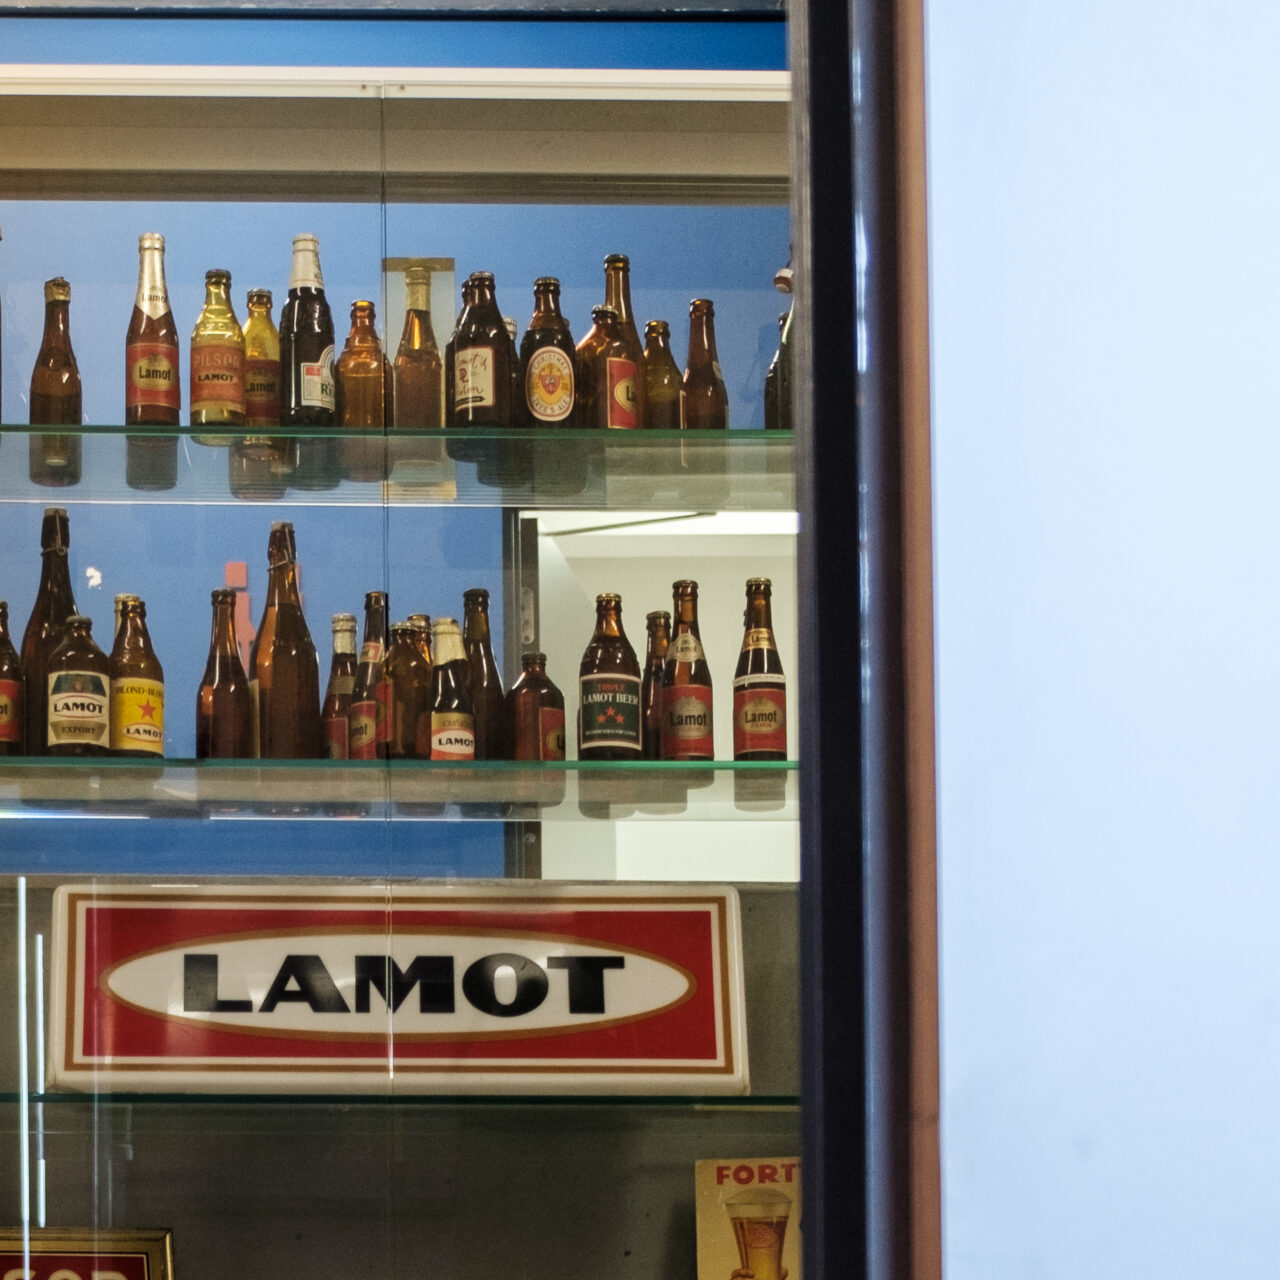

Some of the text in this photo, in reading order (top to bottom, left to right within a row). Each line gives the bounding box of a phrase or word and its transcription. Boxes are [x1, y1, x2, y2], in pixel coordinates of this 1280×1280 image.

[139, 365, 171, 380] Lamot
[198, 373, 234, 382] LAMOT
[583, 692, 639, 706] LAMOT BEER
[54, 702, 104, 714] LAMOT
[670, 711, 707, 727] Lamot
[744, 710, 777, 724] Lamot
[62, 726, 96, 735] EXPORT
[183, 953, 625, 1017] LAMOT
